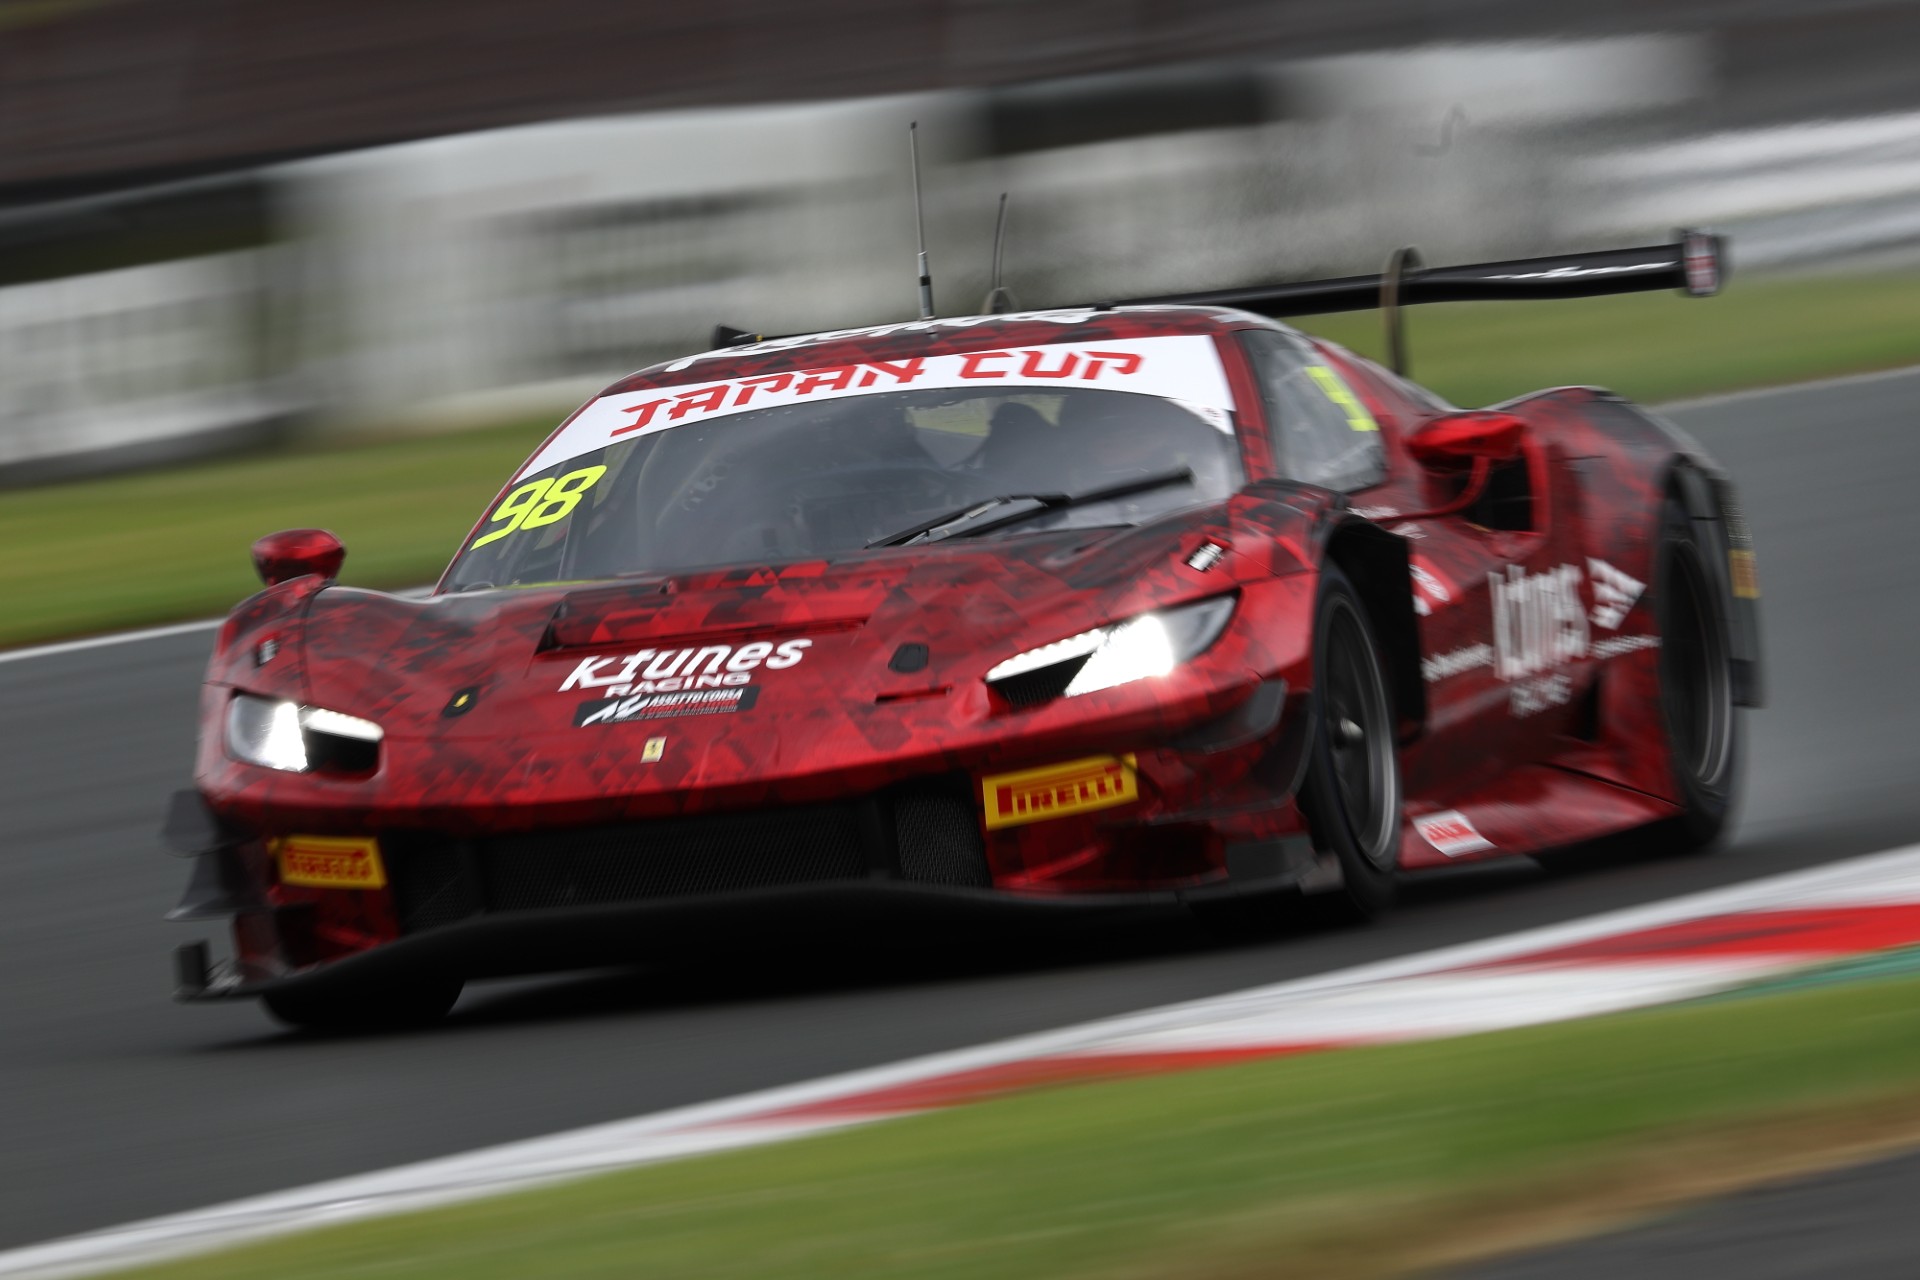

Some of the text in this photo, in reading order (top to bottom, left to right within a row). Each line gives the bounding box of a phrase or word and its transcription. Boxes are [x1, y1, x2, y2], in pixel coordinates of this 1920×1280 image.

[610, 350, 1143, 438] JAPAN CUP
[469, 465, 607, 551] 98
[604, 671, 752, 698] RACING
[647, 690, 703, 707] ASSETTO
[702, 688, 744, 704] CORSA
[996, 764, 1124, 817] PIRELLI
